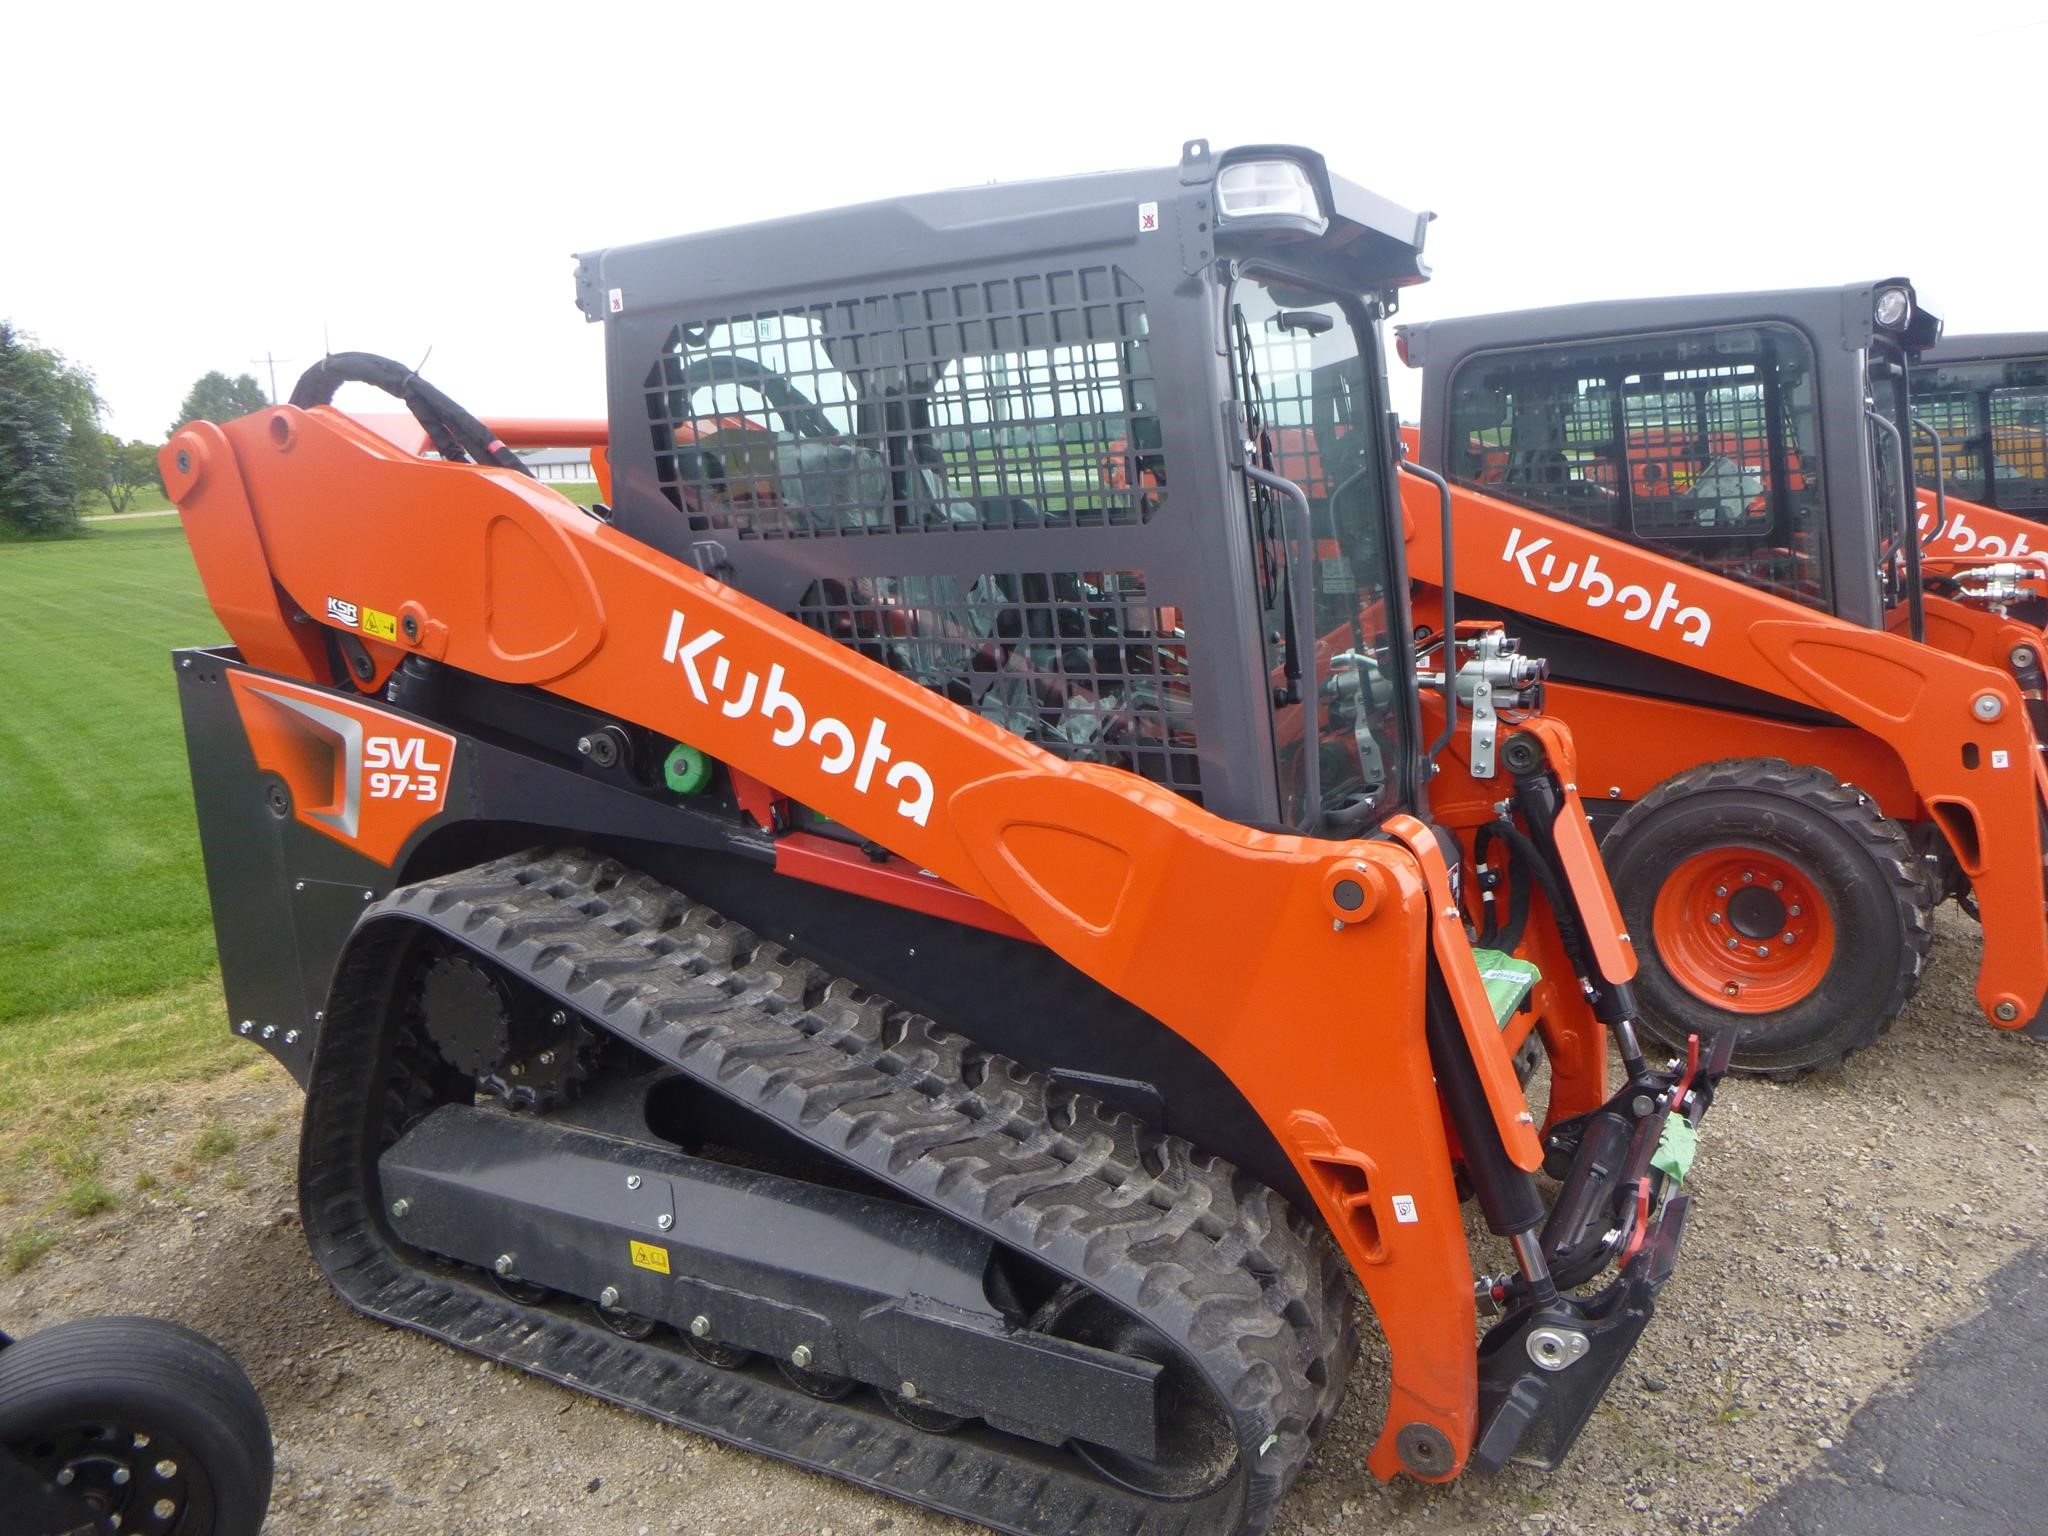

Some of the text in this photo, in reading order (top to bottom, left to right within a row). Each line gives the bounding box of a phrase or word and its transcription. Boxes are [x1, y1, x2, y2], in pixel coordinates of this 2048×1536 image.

[1502, 527, 1711, 648] Kubota
[328, 596, 357, 618] KSR
[662, 609, 934, 827] Kubota
[364, 736, 440, 772] SVL
[370, 772, 437, 801] 97-3
